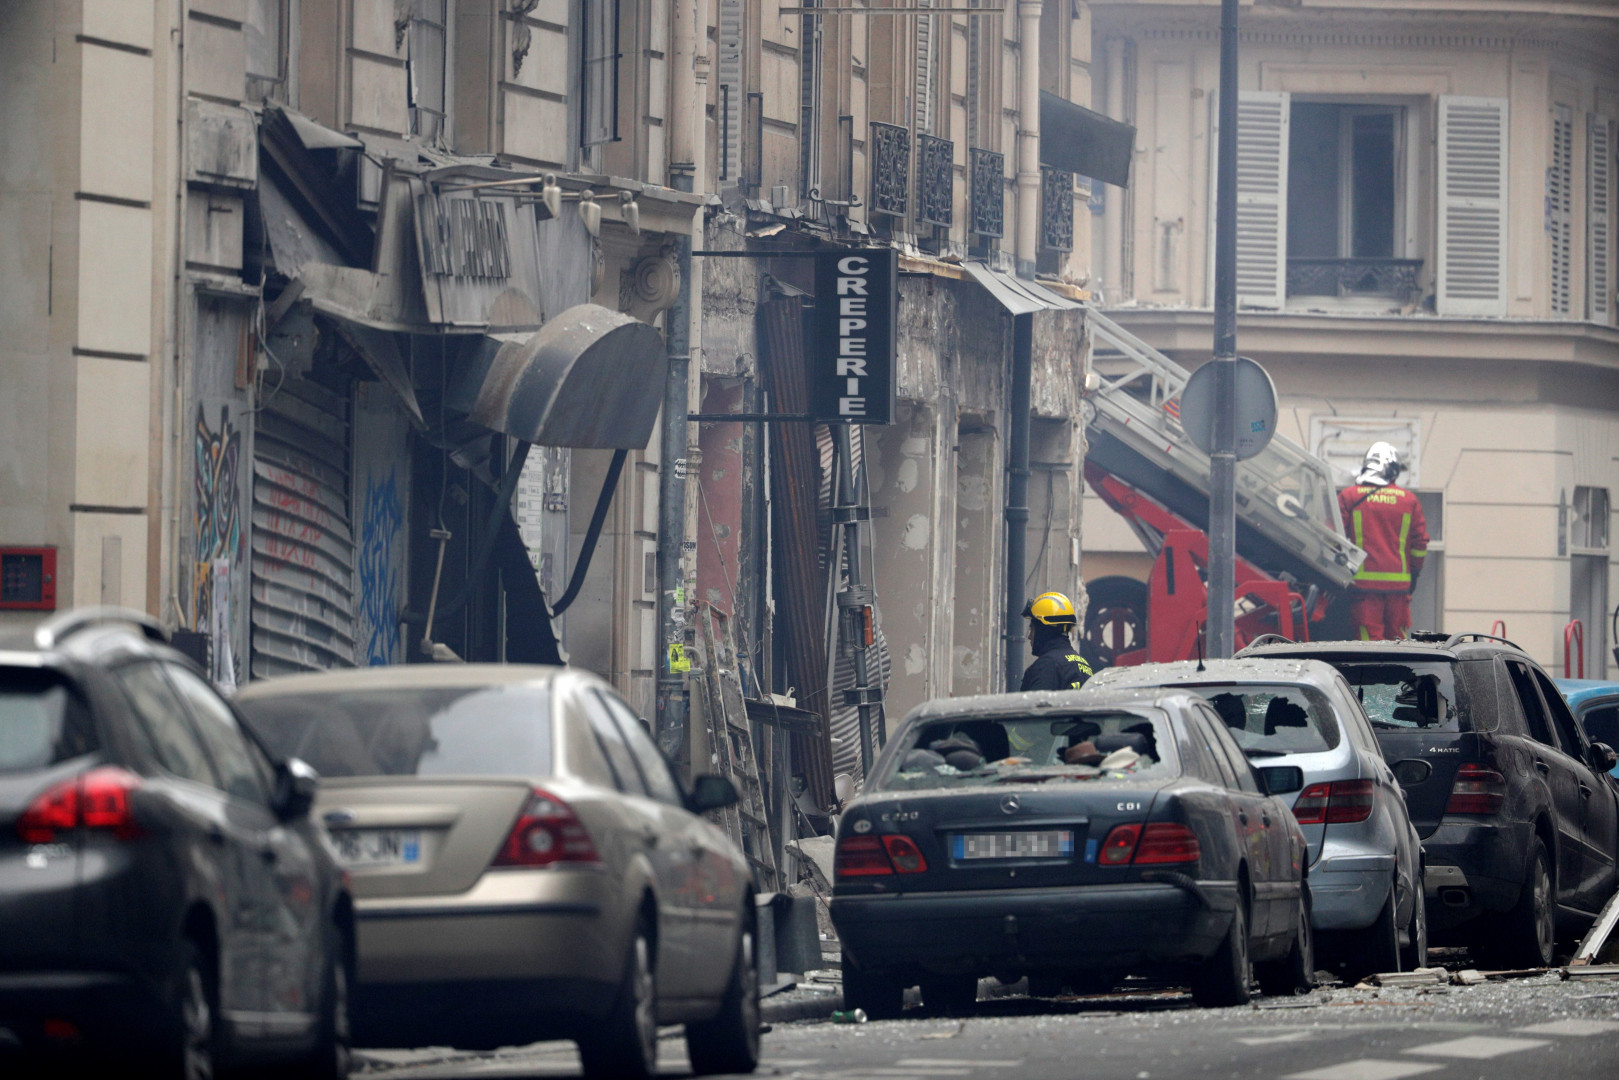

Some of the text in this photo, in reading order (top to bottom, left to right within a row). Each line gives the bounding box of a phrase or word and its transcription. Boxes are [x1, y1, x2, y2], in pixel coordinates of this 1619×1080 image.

[837, 256, 869, 416] CREPERIE
[1366, 494, 1397, 505] PARIS
[1117, 802, 1140, 811] CDI
